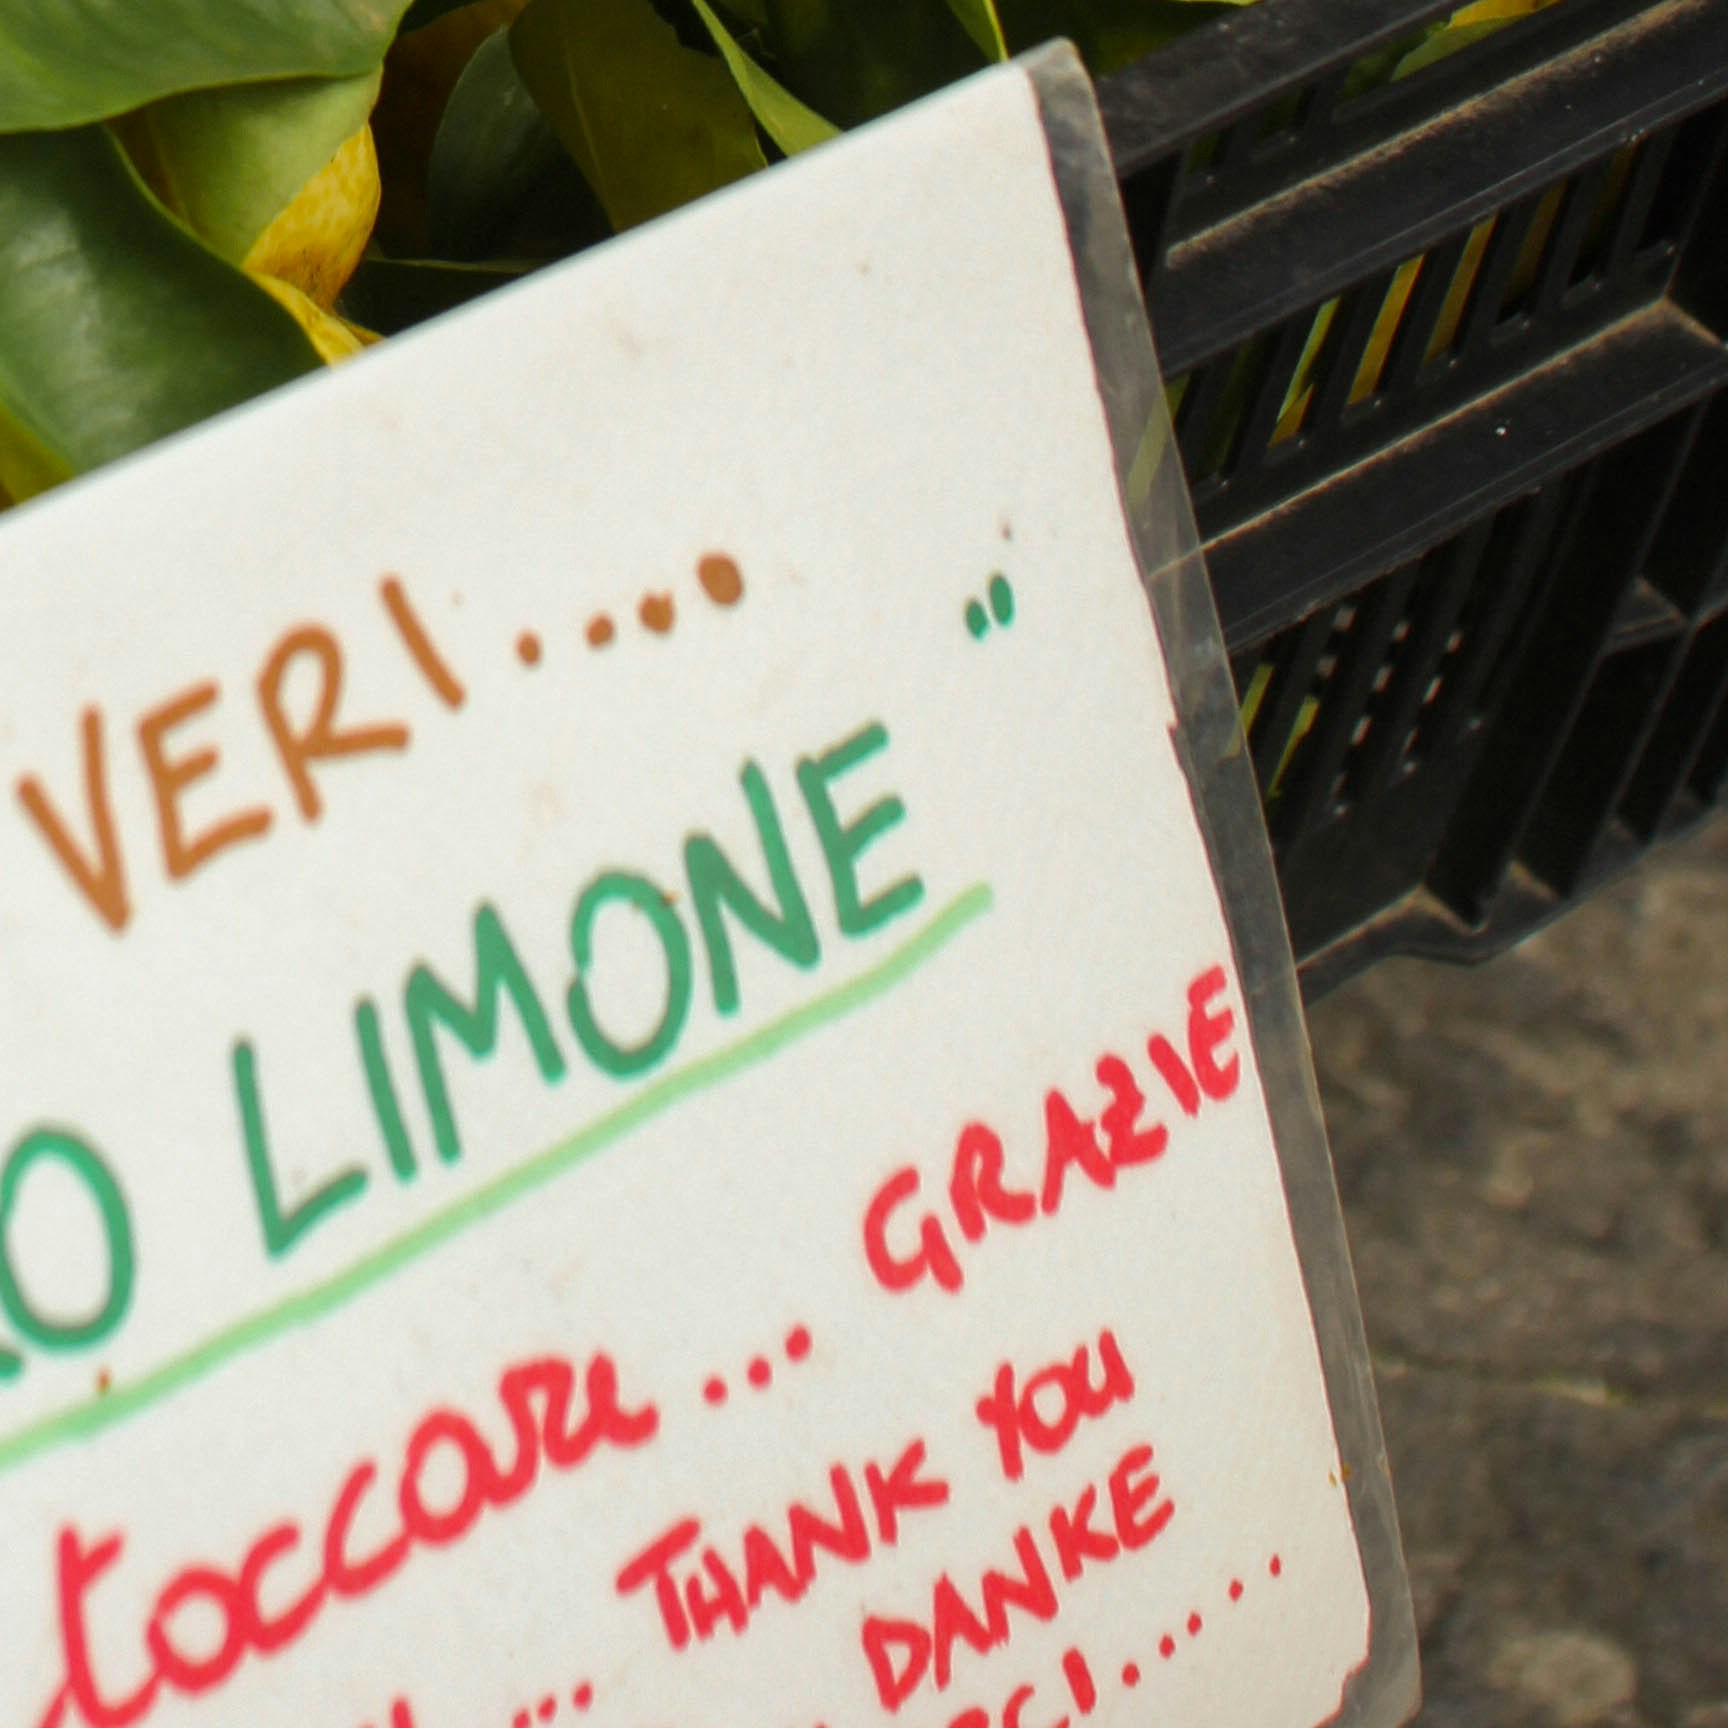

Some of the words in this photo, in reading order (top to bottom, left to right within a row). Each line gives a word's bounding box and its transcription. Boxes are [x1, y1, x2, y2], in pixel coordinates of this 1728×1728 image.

[861, 964, 1240, 1293] GRAZIE
[614, 1439, 951, 1651] THANK
[974, 1328, 1136, 1481] YOU
[860, 1443, 1176, 1714] DANKE
